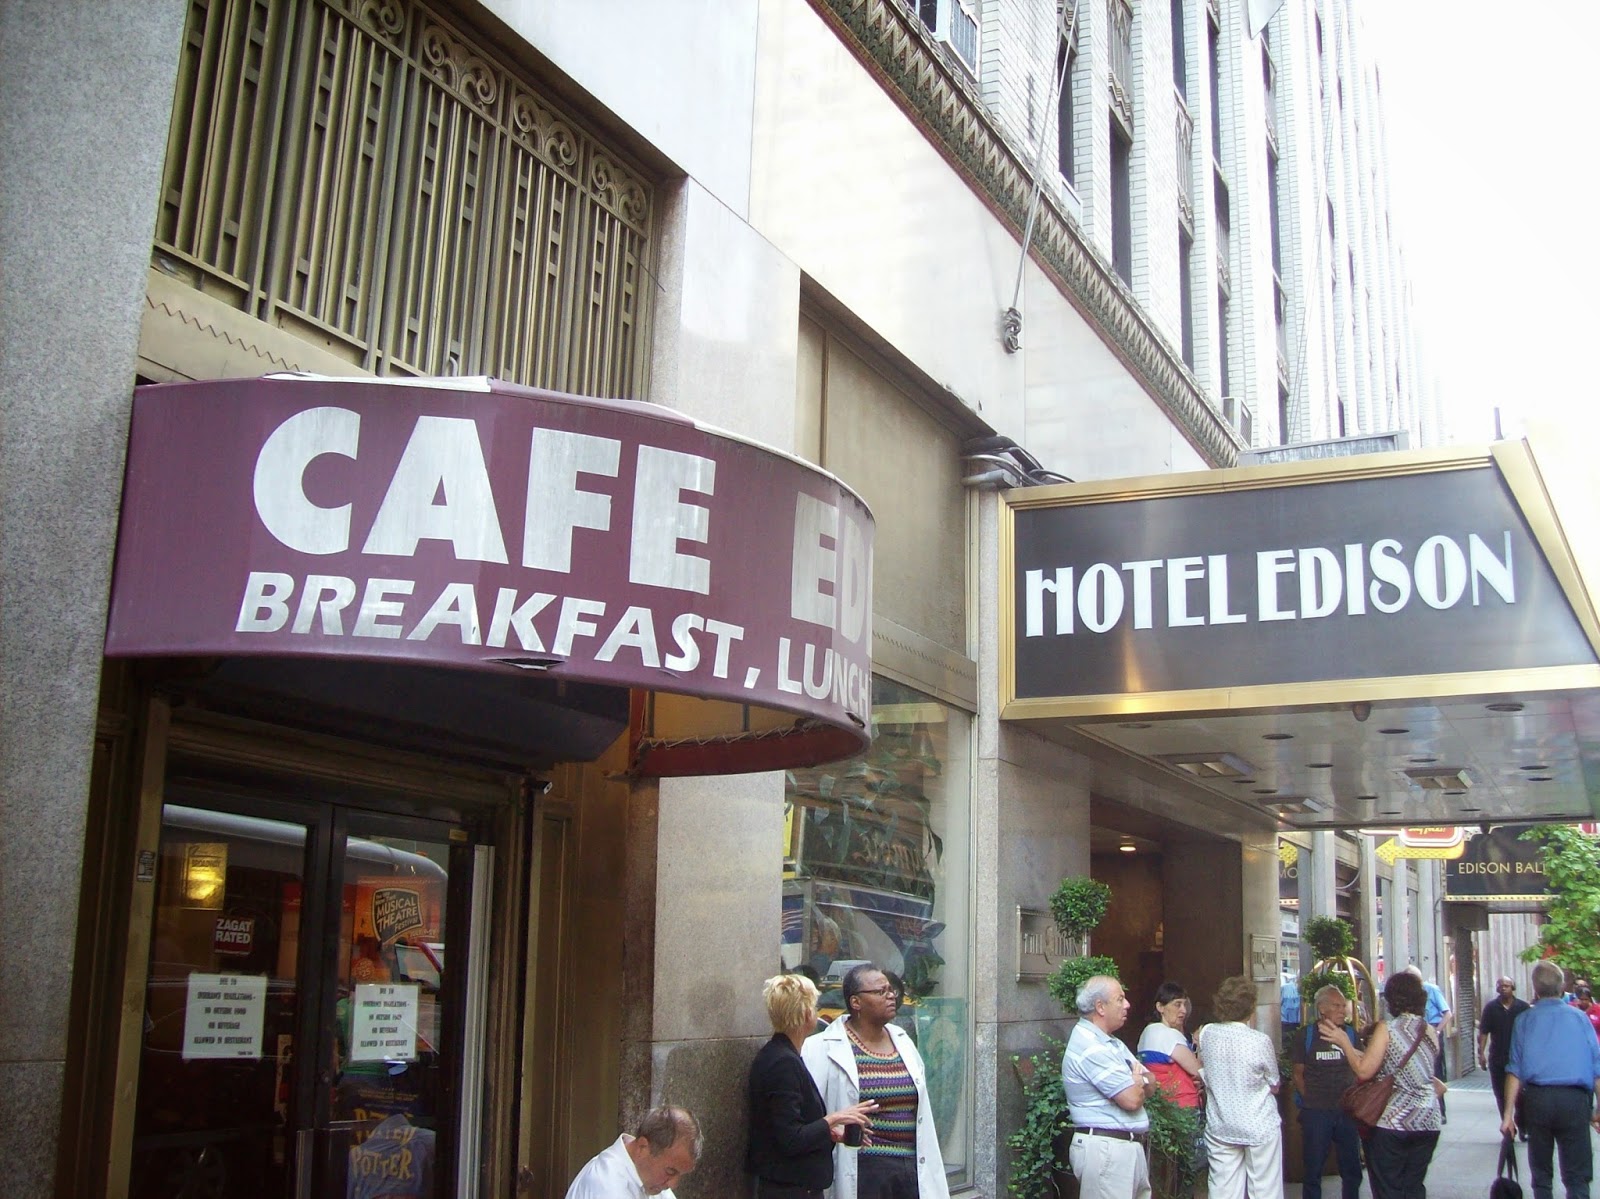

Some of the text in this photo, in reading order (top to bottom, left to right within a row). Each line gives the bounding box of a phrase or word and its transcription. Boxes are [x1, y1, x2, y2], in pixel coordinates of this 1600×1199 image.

[252, 405, 717, 596] CAFE
[1025, 530, 1516, 638] HOTEL EDISON
[234, 571, 870, 723] BREAKFAST, LUNCH
[1458, 861, 1511, 875] EDISON
[376, 896, 416, 920] MUSICAL
[376, 906, 419, 932] THEATRE
[215, 930, 251, 944] RATED
[216, 918, 252, 932] ZAGAT
[350, 1145, 414, 1180] POTTER
